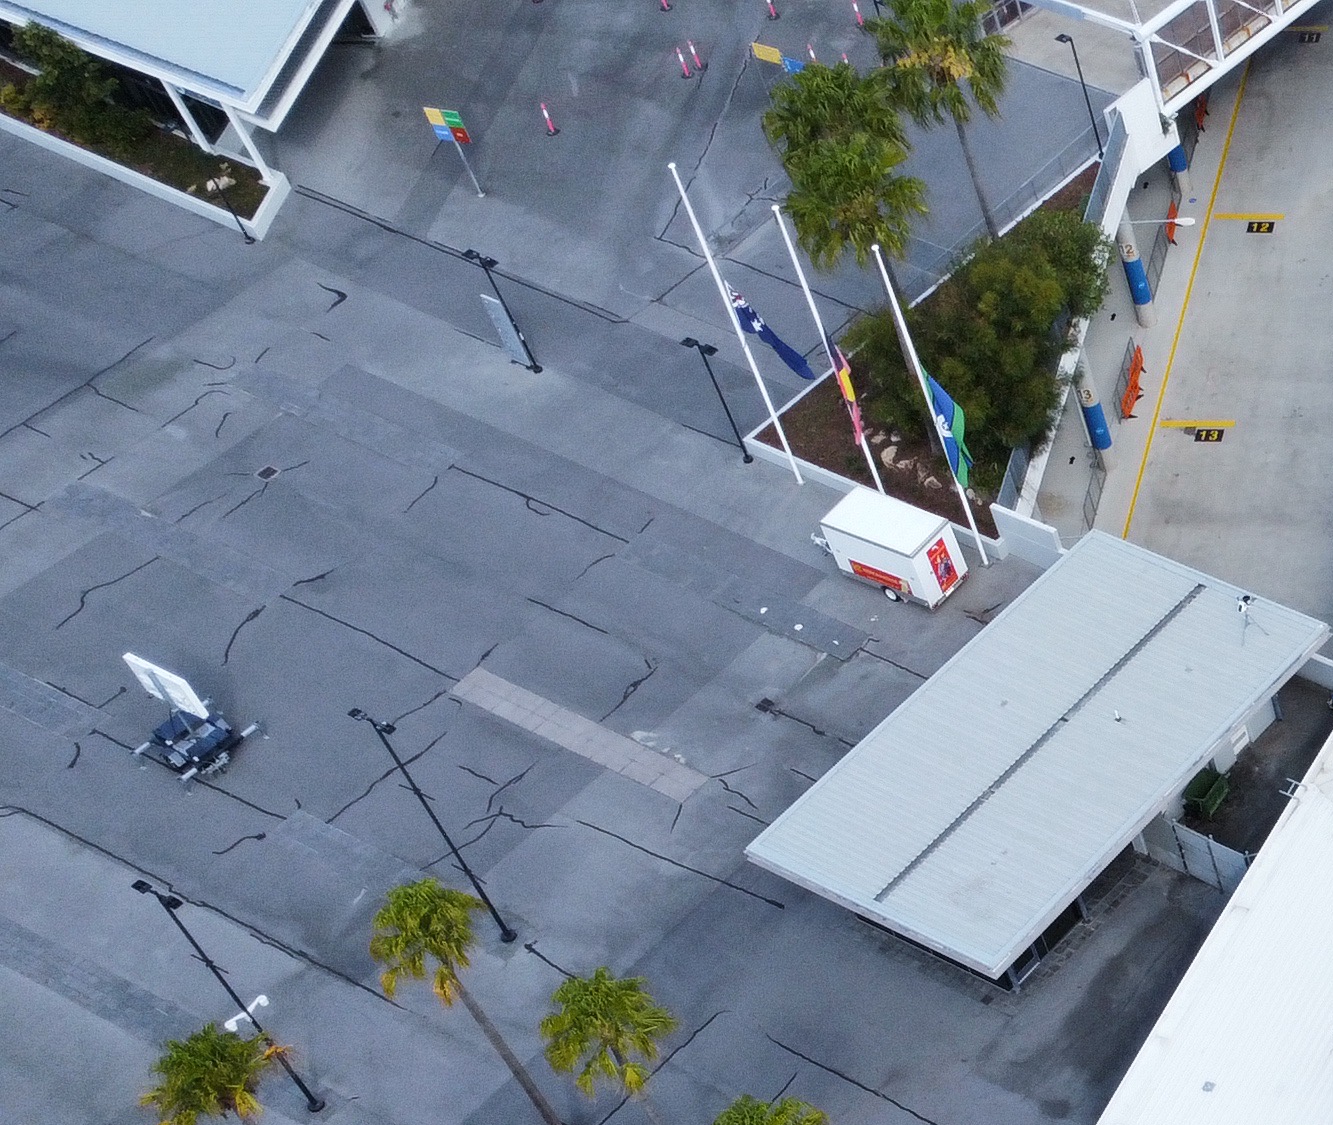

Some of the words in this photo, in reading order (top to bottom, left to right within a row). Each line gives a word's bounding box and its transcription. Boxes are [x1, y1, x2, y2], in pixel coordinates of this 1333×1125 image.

[1251, 222, 1271, 232] 12
[1118, 244, 1134, 255] 12
[1078, 388, 1093, 401] 13
[1199, 430, 1219, 441] 13
